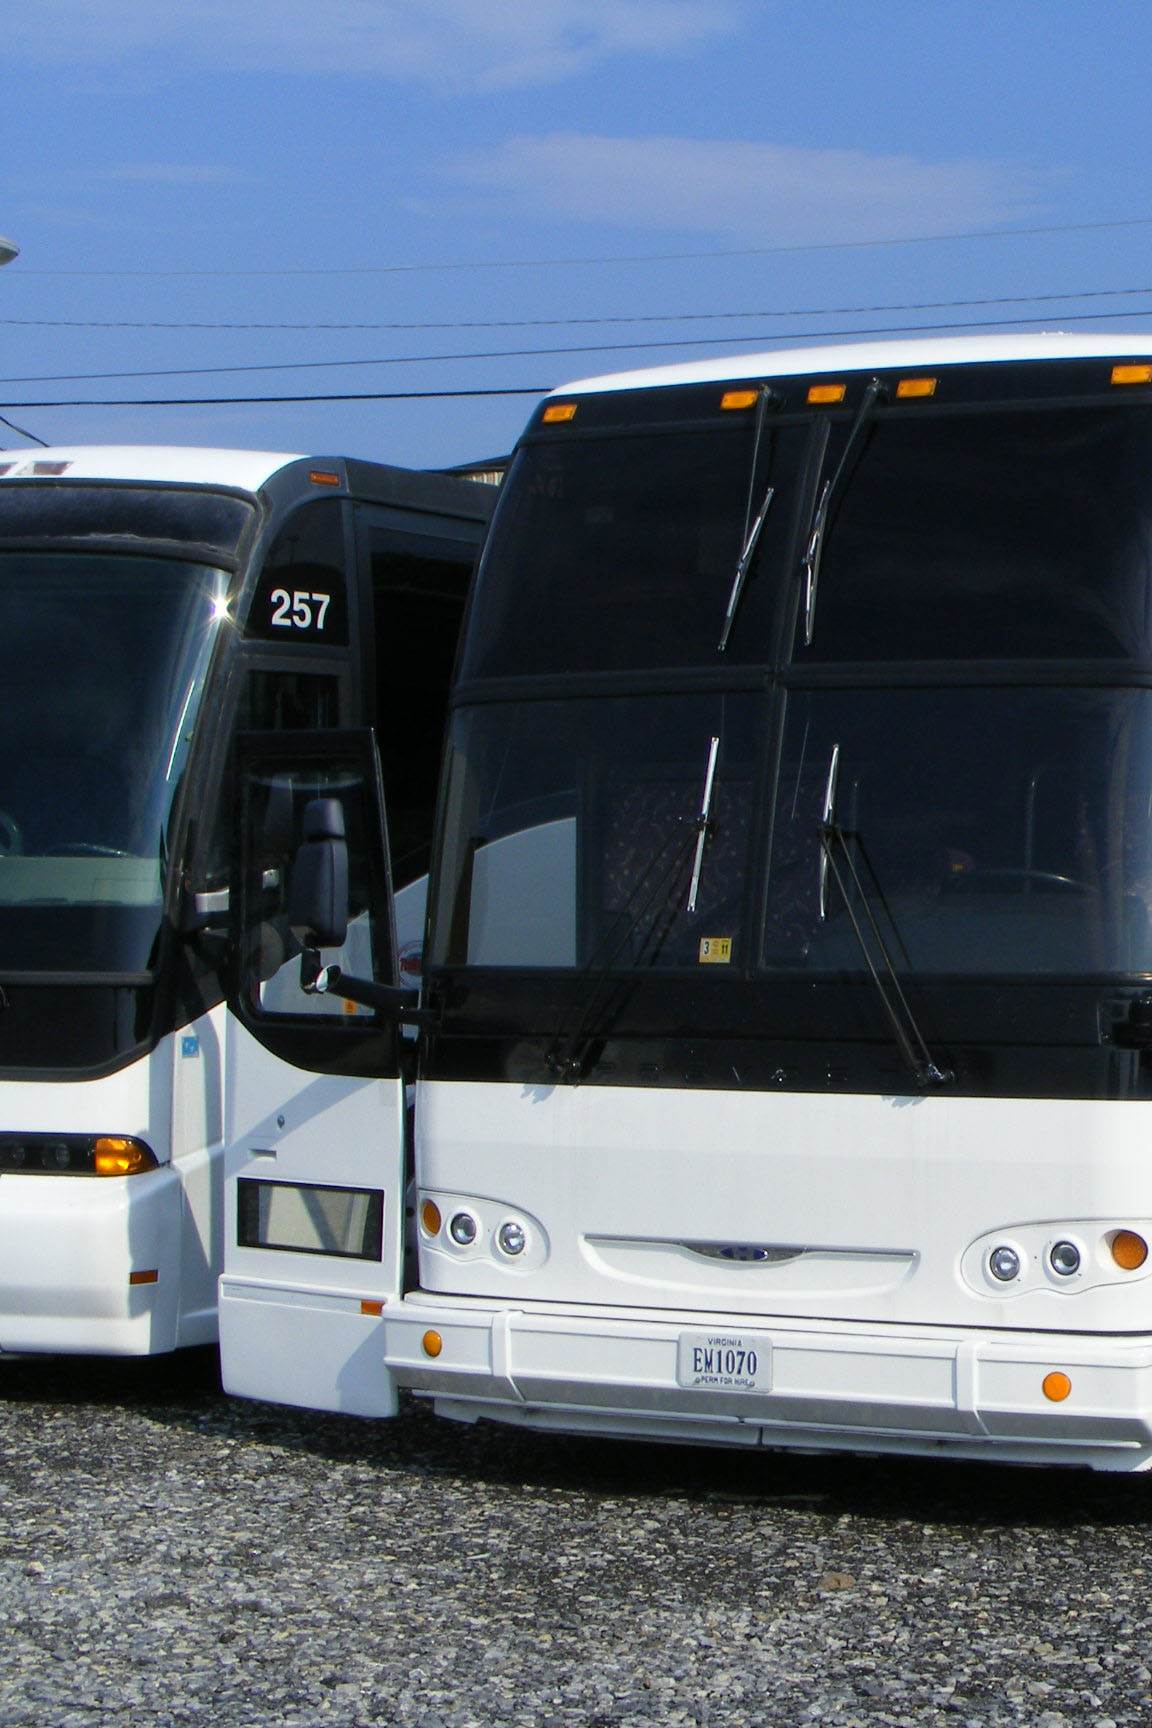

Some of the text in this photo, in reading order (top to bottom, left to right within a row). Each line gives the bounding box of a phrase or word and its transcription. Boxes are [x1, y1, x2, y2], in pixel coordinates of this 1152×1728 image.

[271, 588, 330, 629] 257
[703, 940, 729, 955] 3 11
[707, 1338, 742, 1347] VIRGINIA
[693, 1347, 757, 1375] EM1070
[701, 1375, 718, 1384] PERM
[720, 1376, 733, 1385] FOR
